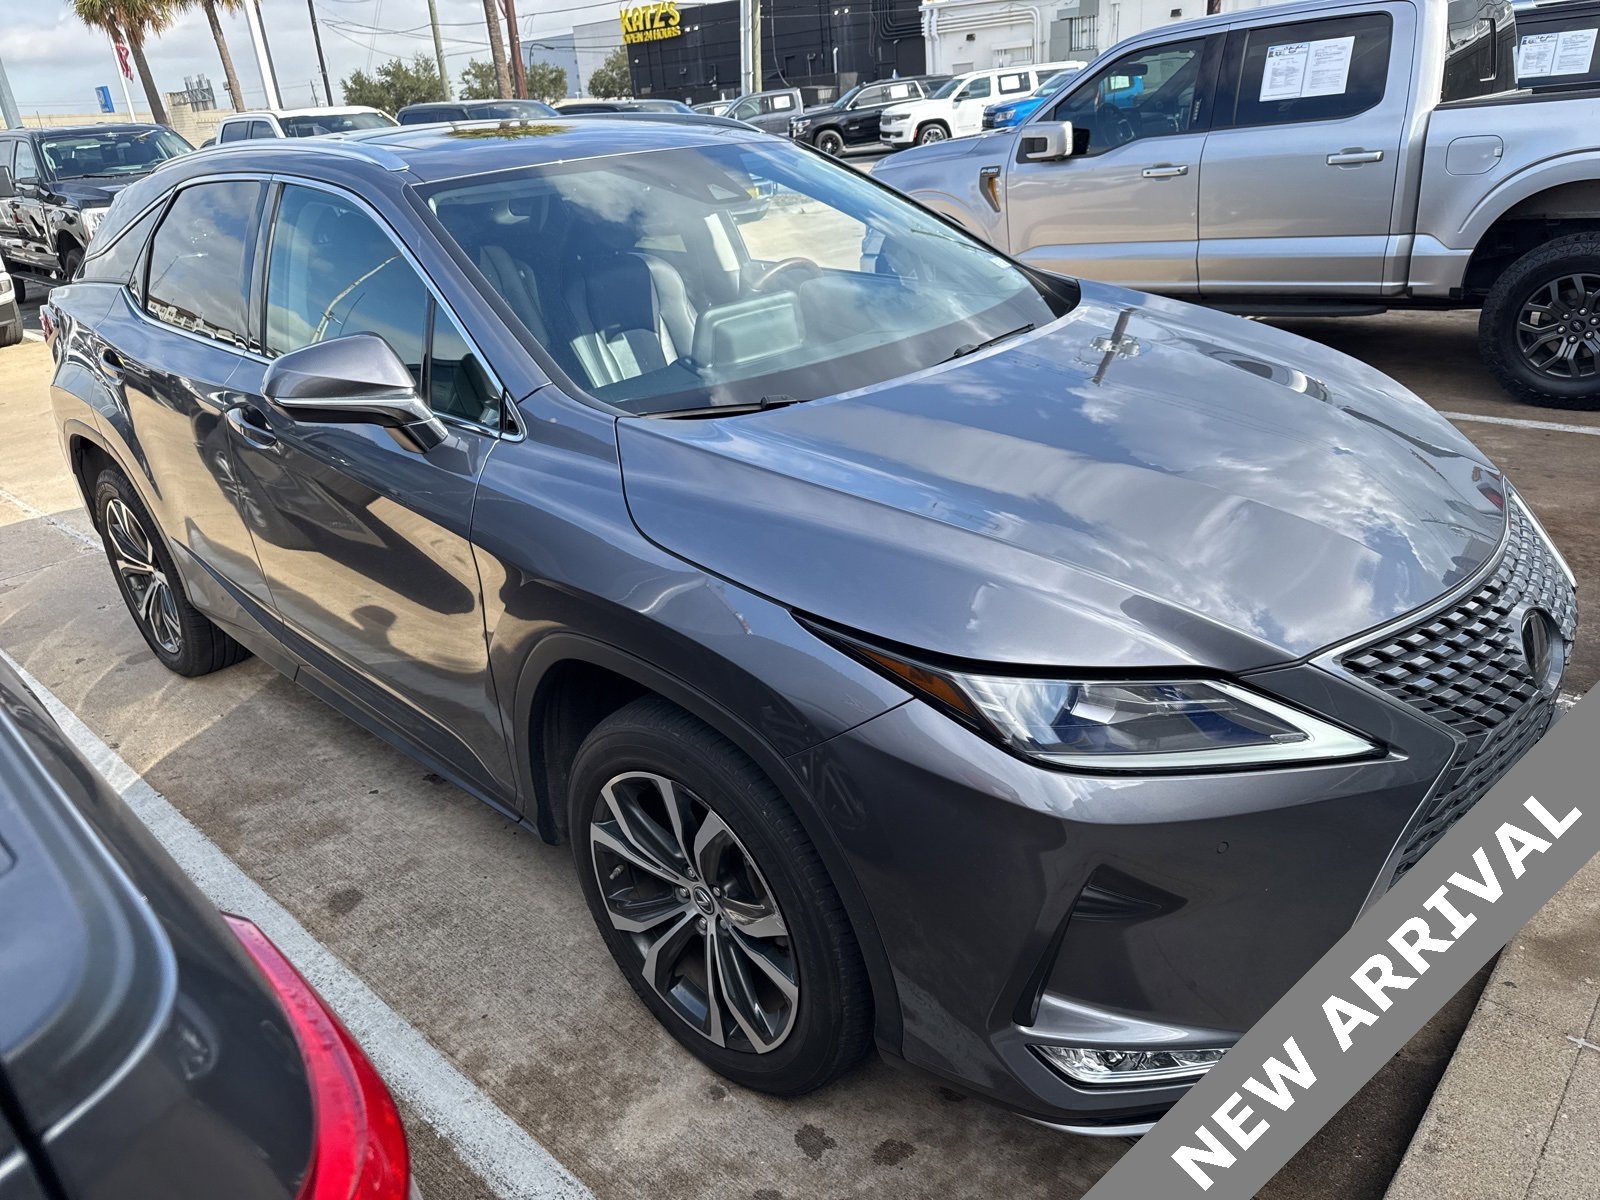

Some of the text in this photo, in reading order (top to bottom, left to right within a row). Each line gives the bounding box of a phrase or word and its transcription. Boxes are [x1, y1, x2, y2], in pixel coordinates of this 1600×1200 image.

[620, 1, 680, 32] KATZ'S
[624, 32, 643, 44] OPEN
[643, 29, 652, 42] 24
